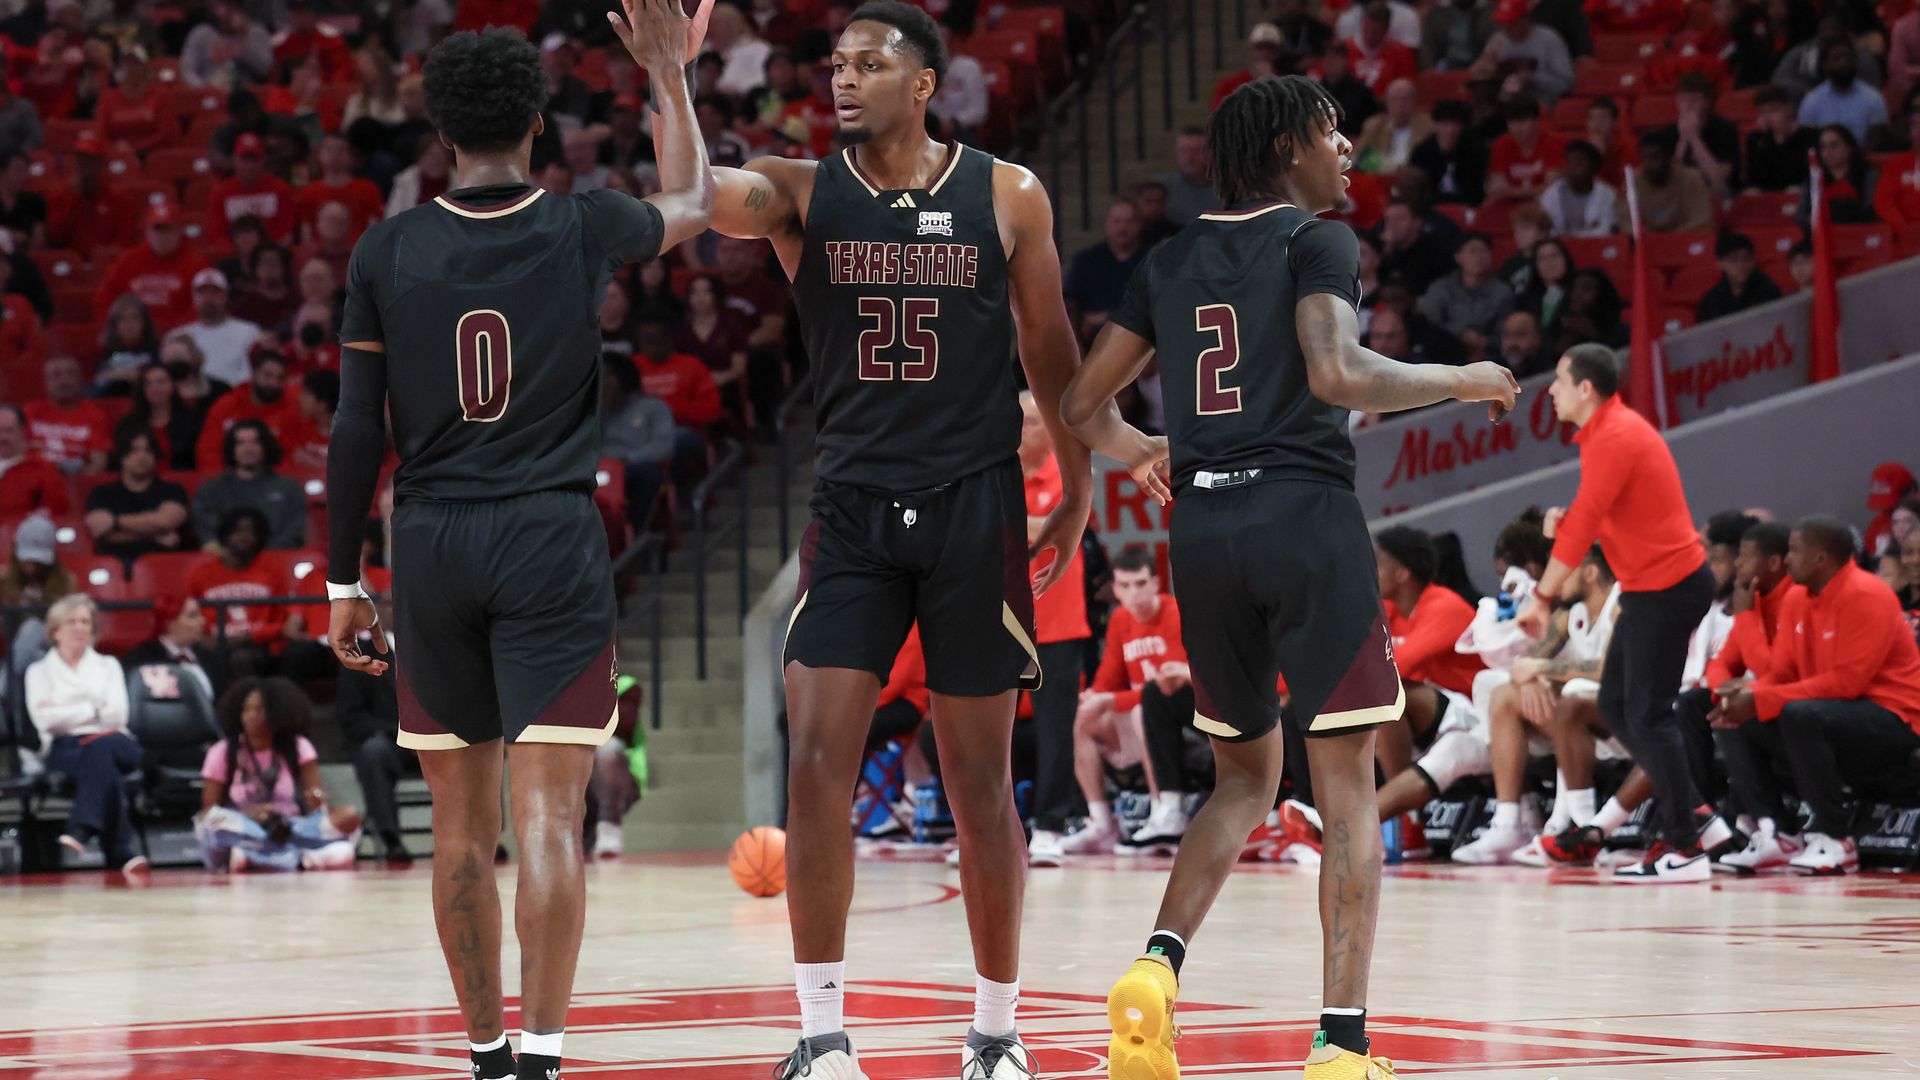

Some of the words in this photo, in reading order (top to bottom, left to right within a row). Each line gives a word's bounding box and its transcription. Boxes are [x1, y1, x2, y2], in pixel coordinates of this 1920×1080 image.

[919, 212, 952, 227] SBC
[826, 241, 900, 284] TEXAS
[903, 243, 978, 288] STATE
[456, 309, 512, 422] 0
[858, 297, 939, 381] 25
[1196, 304, 1242, 415] 2
[1383, 418, 1520, 489] March
